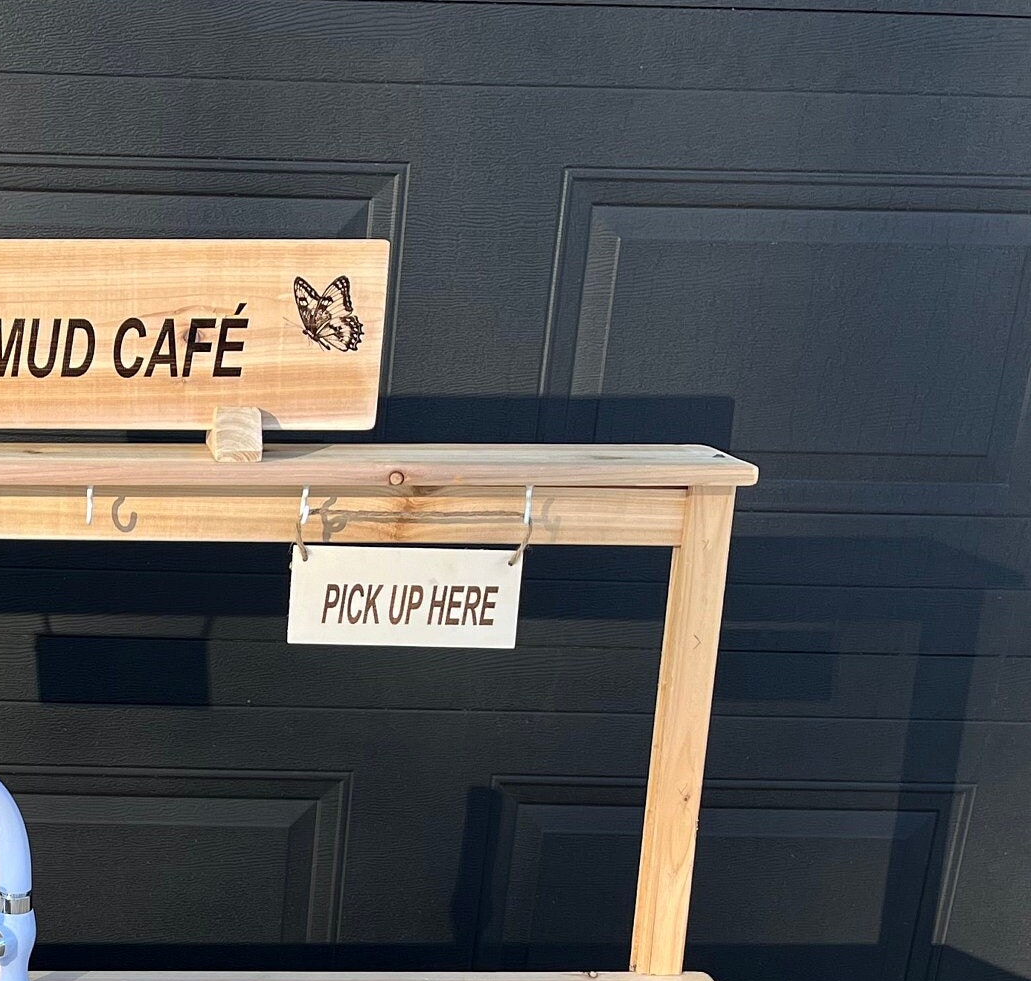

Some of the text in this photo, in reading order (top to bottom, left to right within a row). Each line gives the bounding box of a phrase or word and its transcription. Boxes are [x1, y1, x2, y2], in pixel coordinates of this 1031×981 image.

[112, 301, 250, 379] CAFÉ
[320, 582, 501, 627] PICK UP HERE
